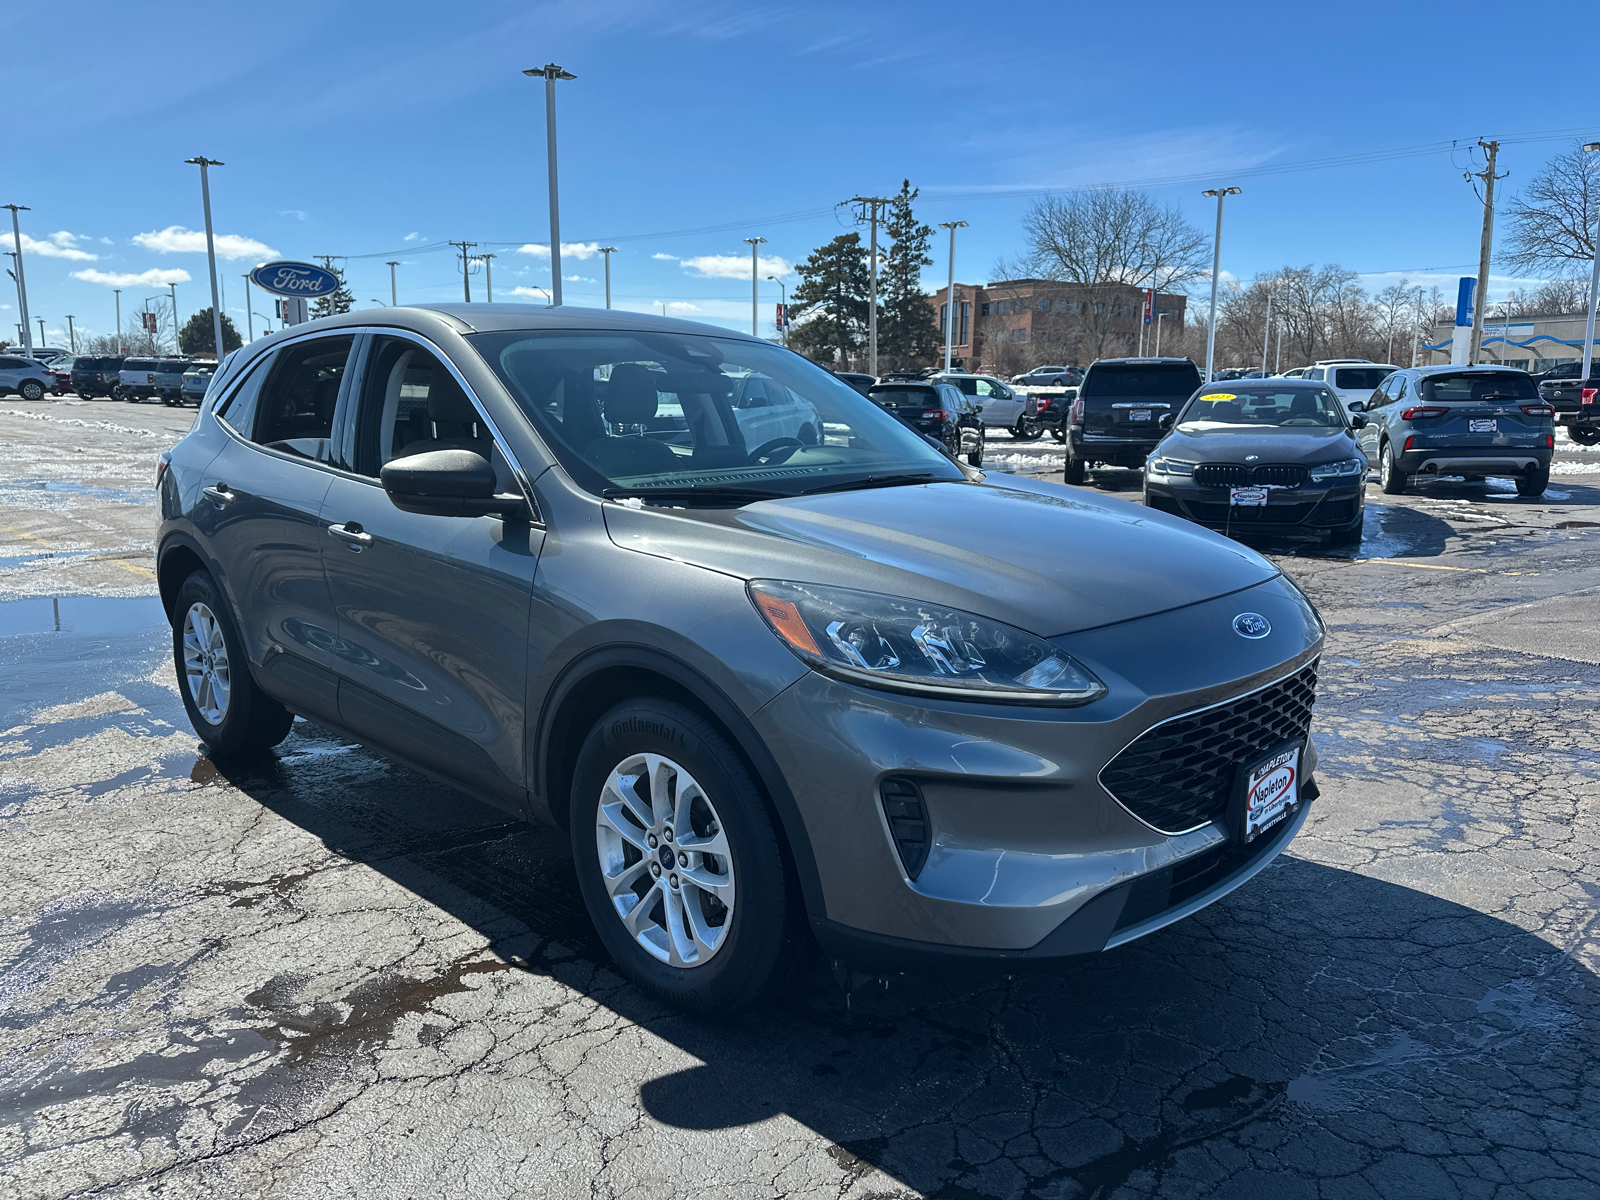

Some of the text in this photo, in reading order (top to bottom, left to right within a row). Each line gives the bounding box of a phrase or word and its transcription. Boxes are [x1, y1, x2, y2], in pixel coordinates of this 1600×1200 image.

[273, 268, 323, 291] Ford
[1242, 617, 1266, 633] Ford
[611, 716, 677, 743] Continental
[1253, 776, 1287, 805] Napleton
[1268, 795, 1291, 812] Libertyville
[1260, 812, 1287, 833] LIBERTYVILLE
